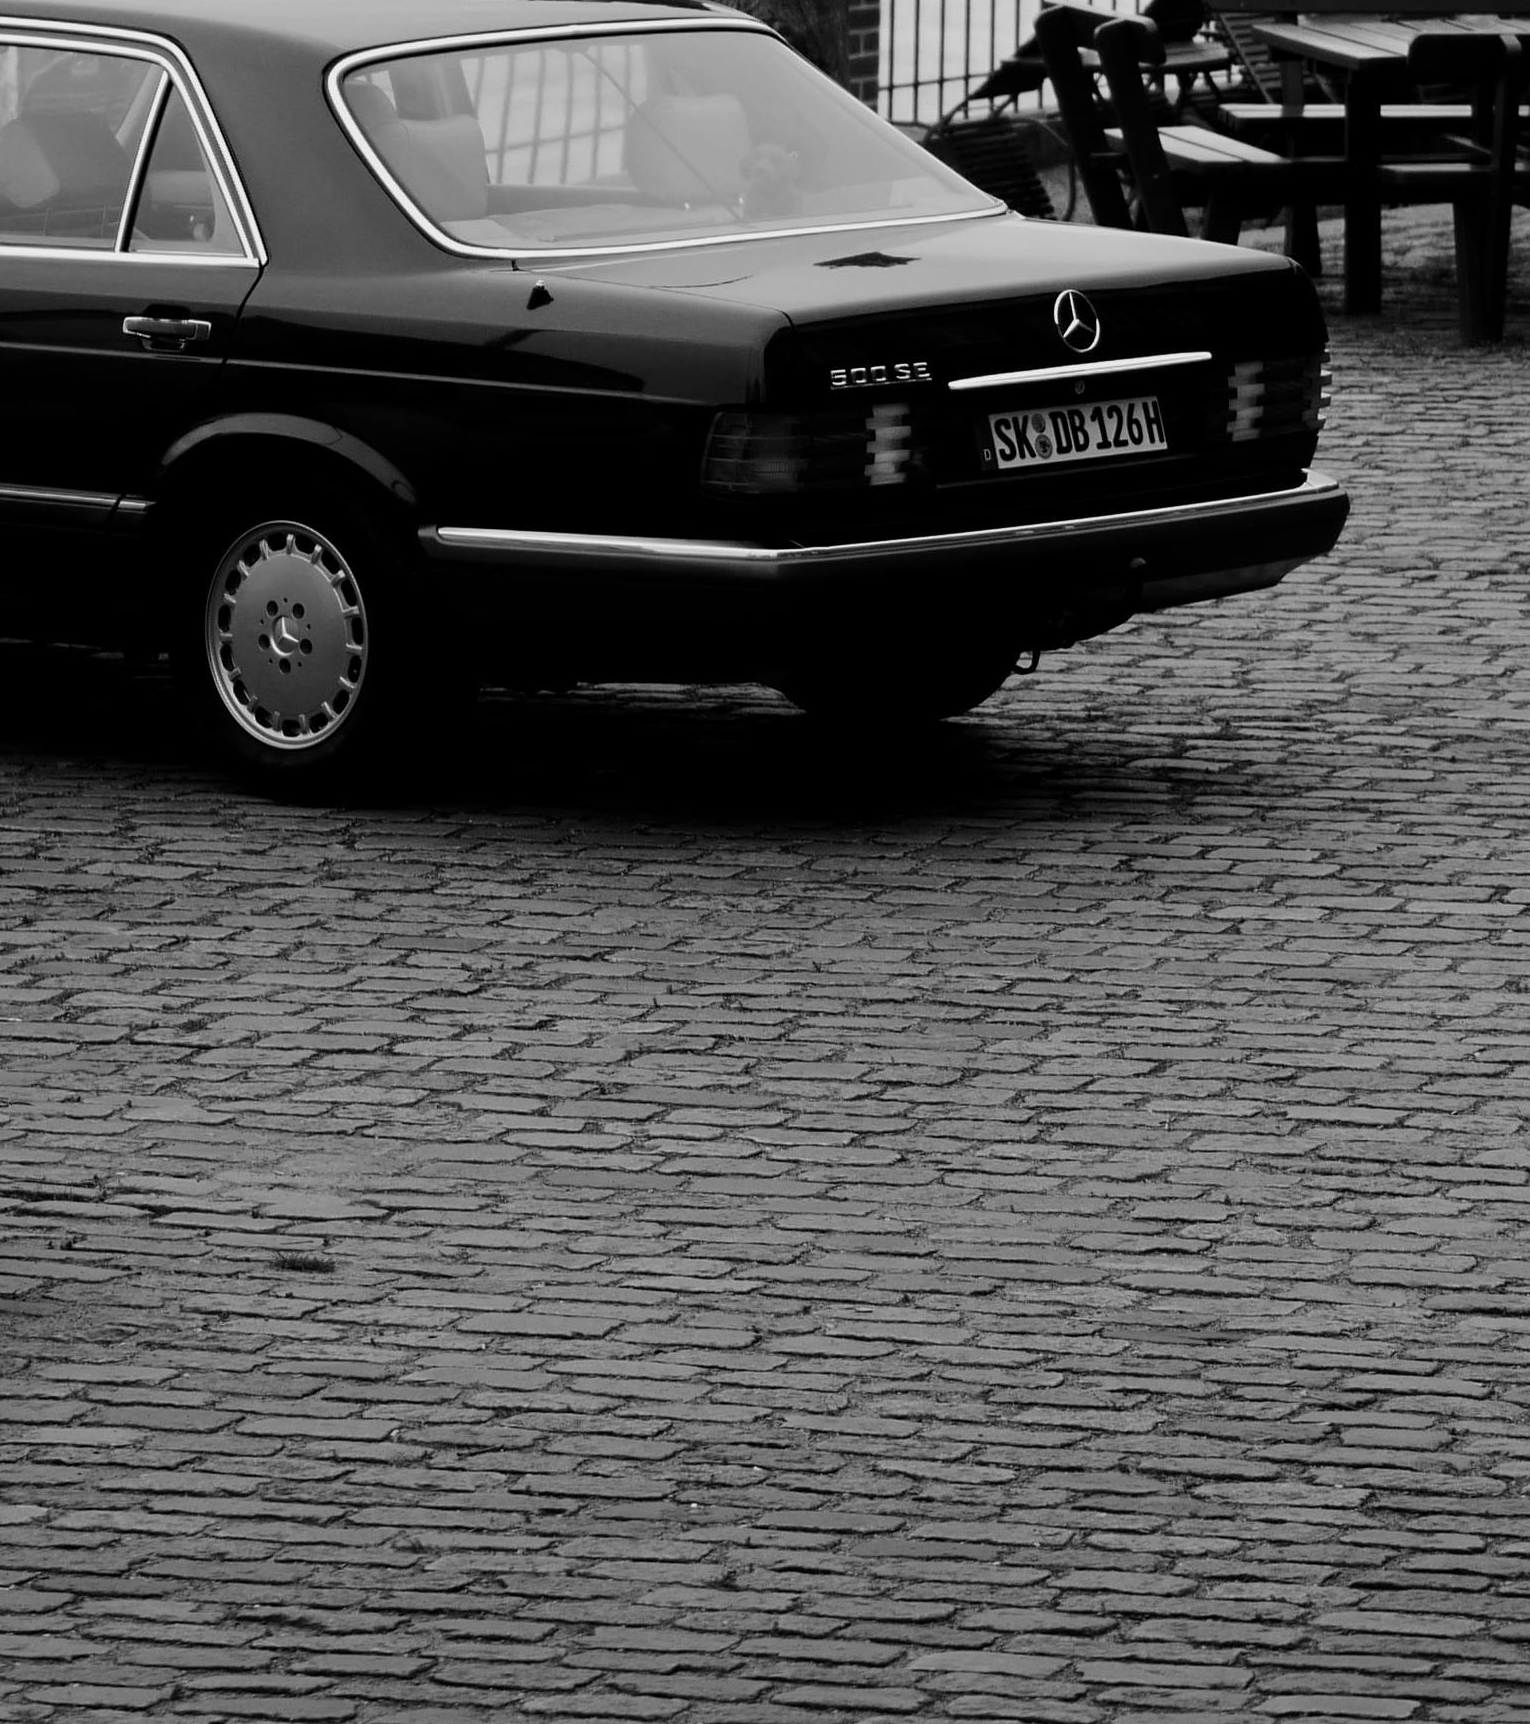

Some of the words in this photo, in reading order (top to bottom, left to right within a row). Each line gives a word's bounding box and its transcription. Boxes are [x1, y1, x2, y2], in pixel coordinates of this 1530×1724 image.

[830, 365, 887, 386] 500
[894, 361, 931, 380] SE
[993, 414, 1037, 462] SK
[983, 448, 992, 461] D
